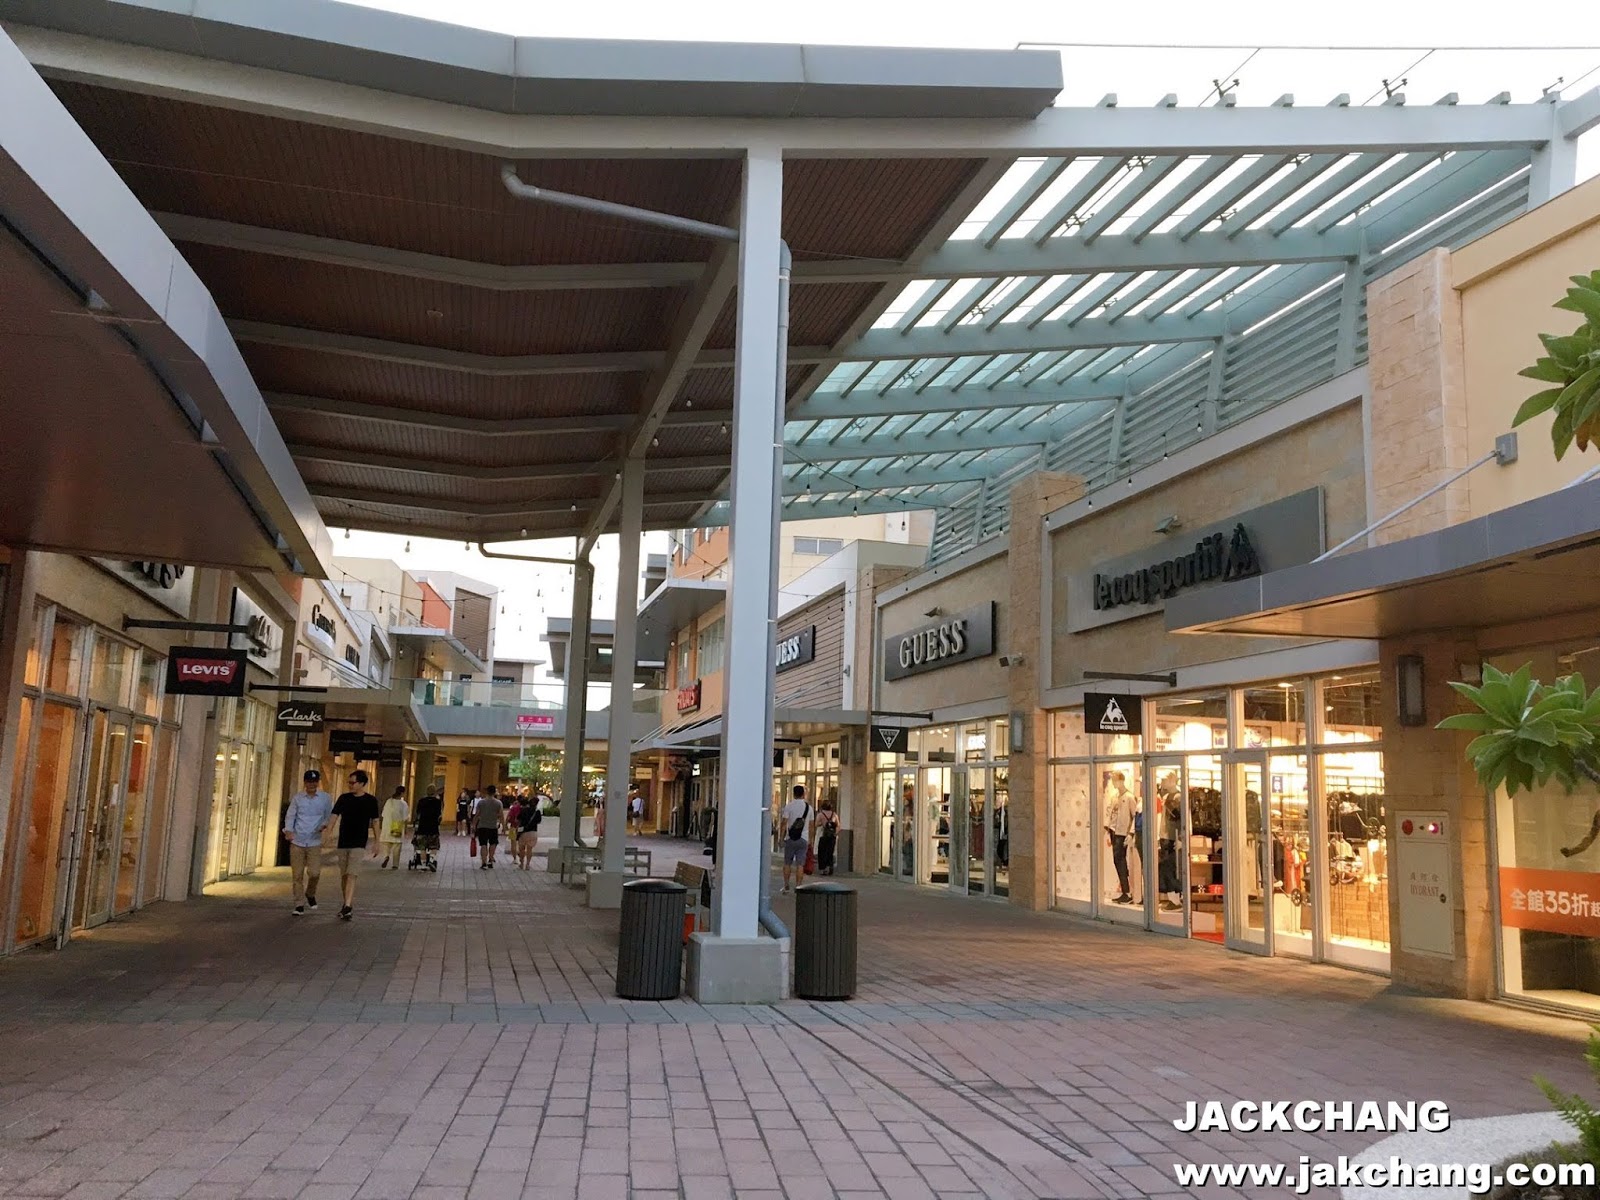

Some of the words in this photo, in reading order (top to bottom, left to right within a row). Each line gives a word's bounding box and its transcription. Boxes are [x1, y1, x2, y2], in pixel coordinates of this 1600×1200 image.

[775, 635, 801, 667] UESS
[899, 619, 966, 669] GUESS
[277, 707, 323, 722] Clarks
